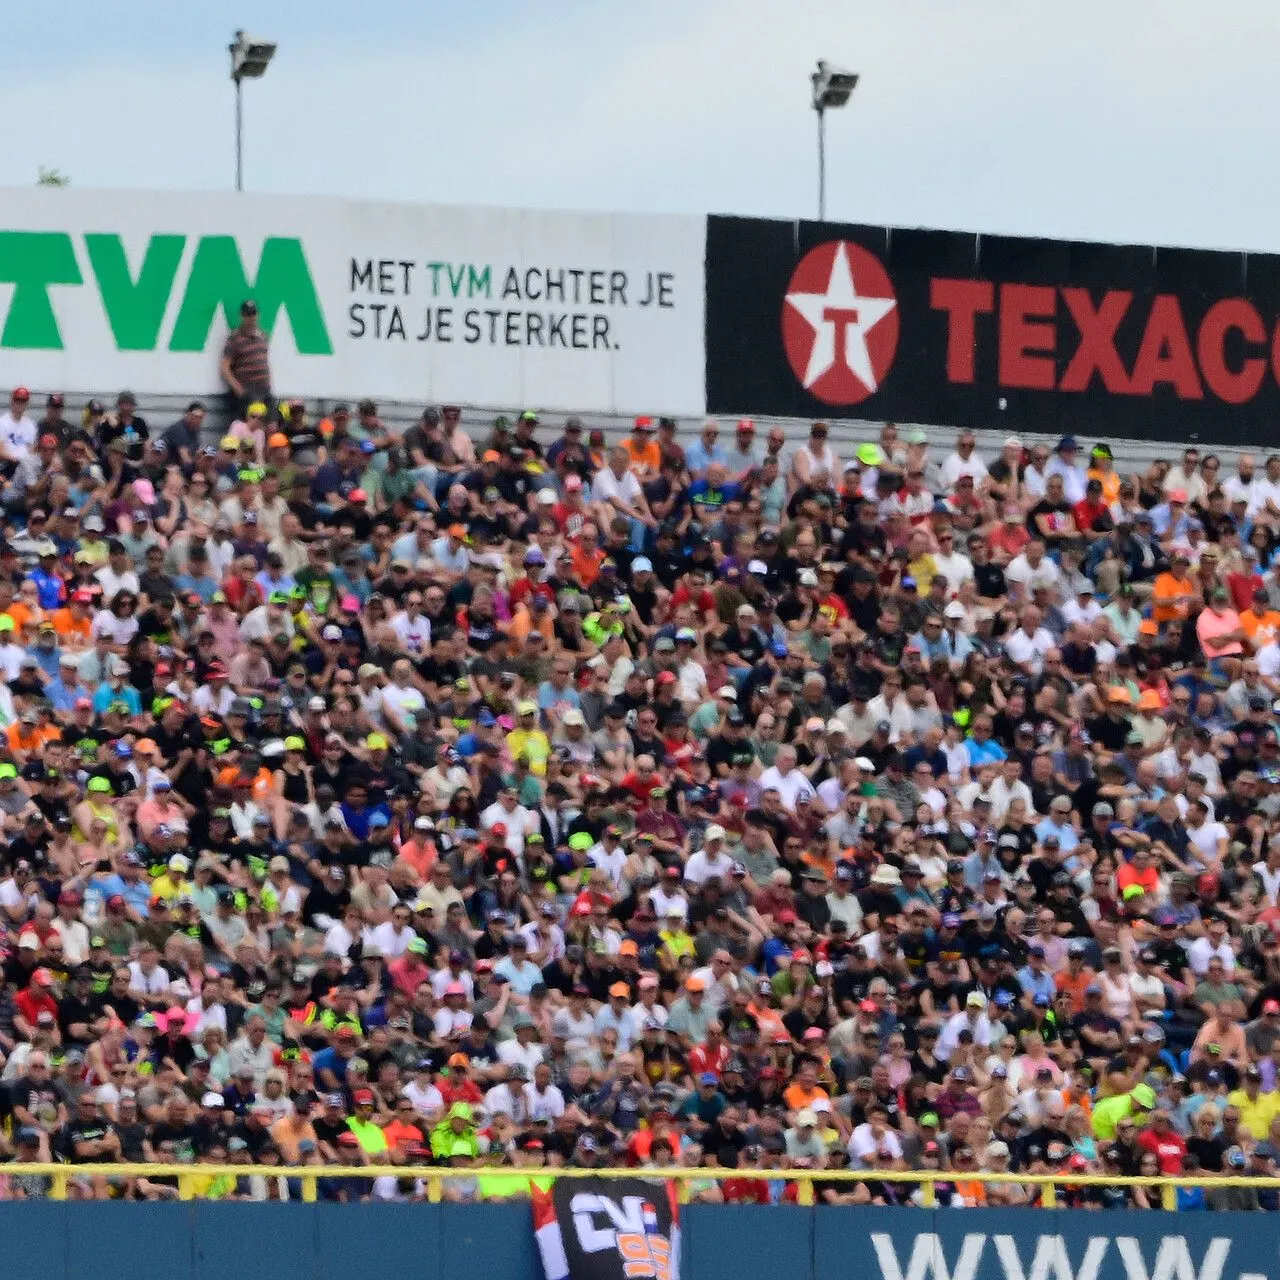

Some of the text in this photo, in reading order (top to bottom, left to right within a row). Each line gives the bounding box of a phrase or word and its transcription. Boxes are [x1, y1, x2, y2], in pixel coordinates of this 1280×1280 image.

[351, 258, 675, 309] MET TVM ACHTER JE
[349, 303, 620, 350] STA JE STERKER.
[931, 278, 1280, 404] TEXAC
